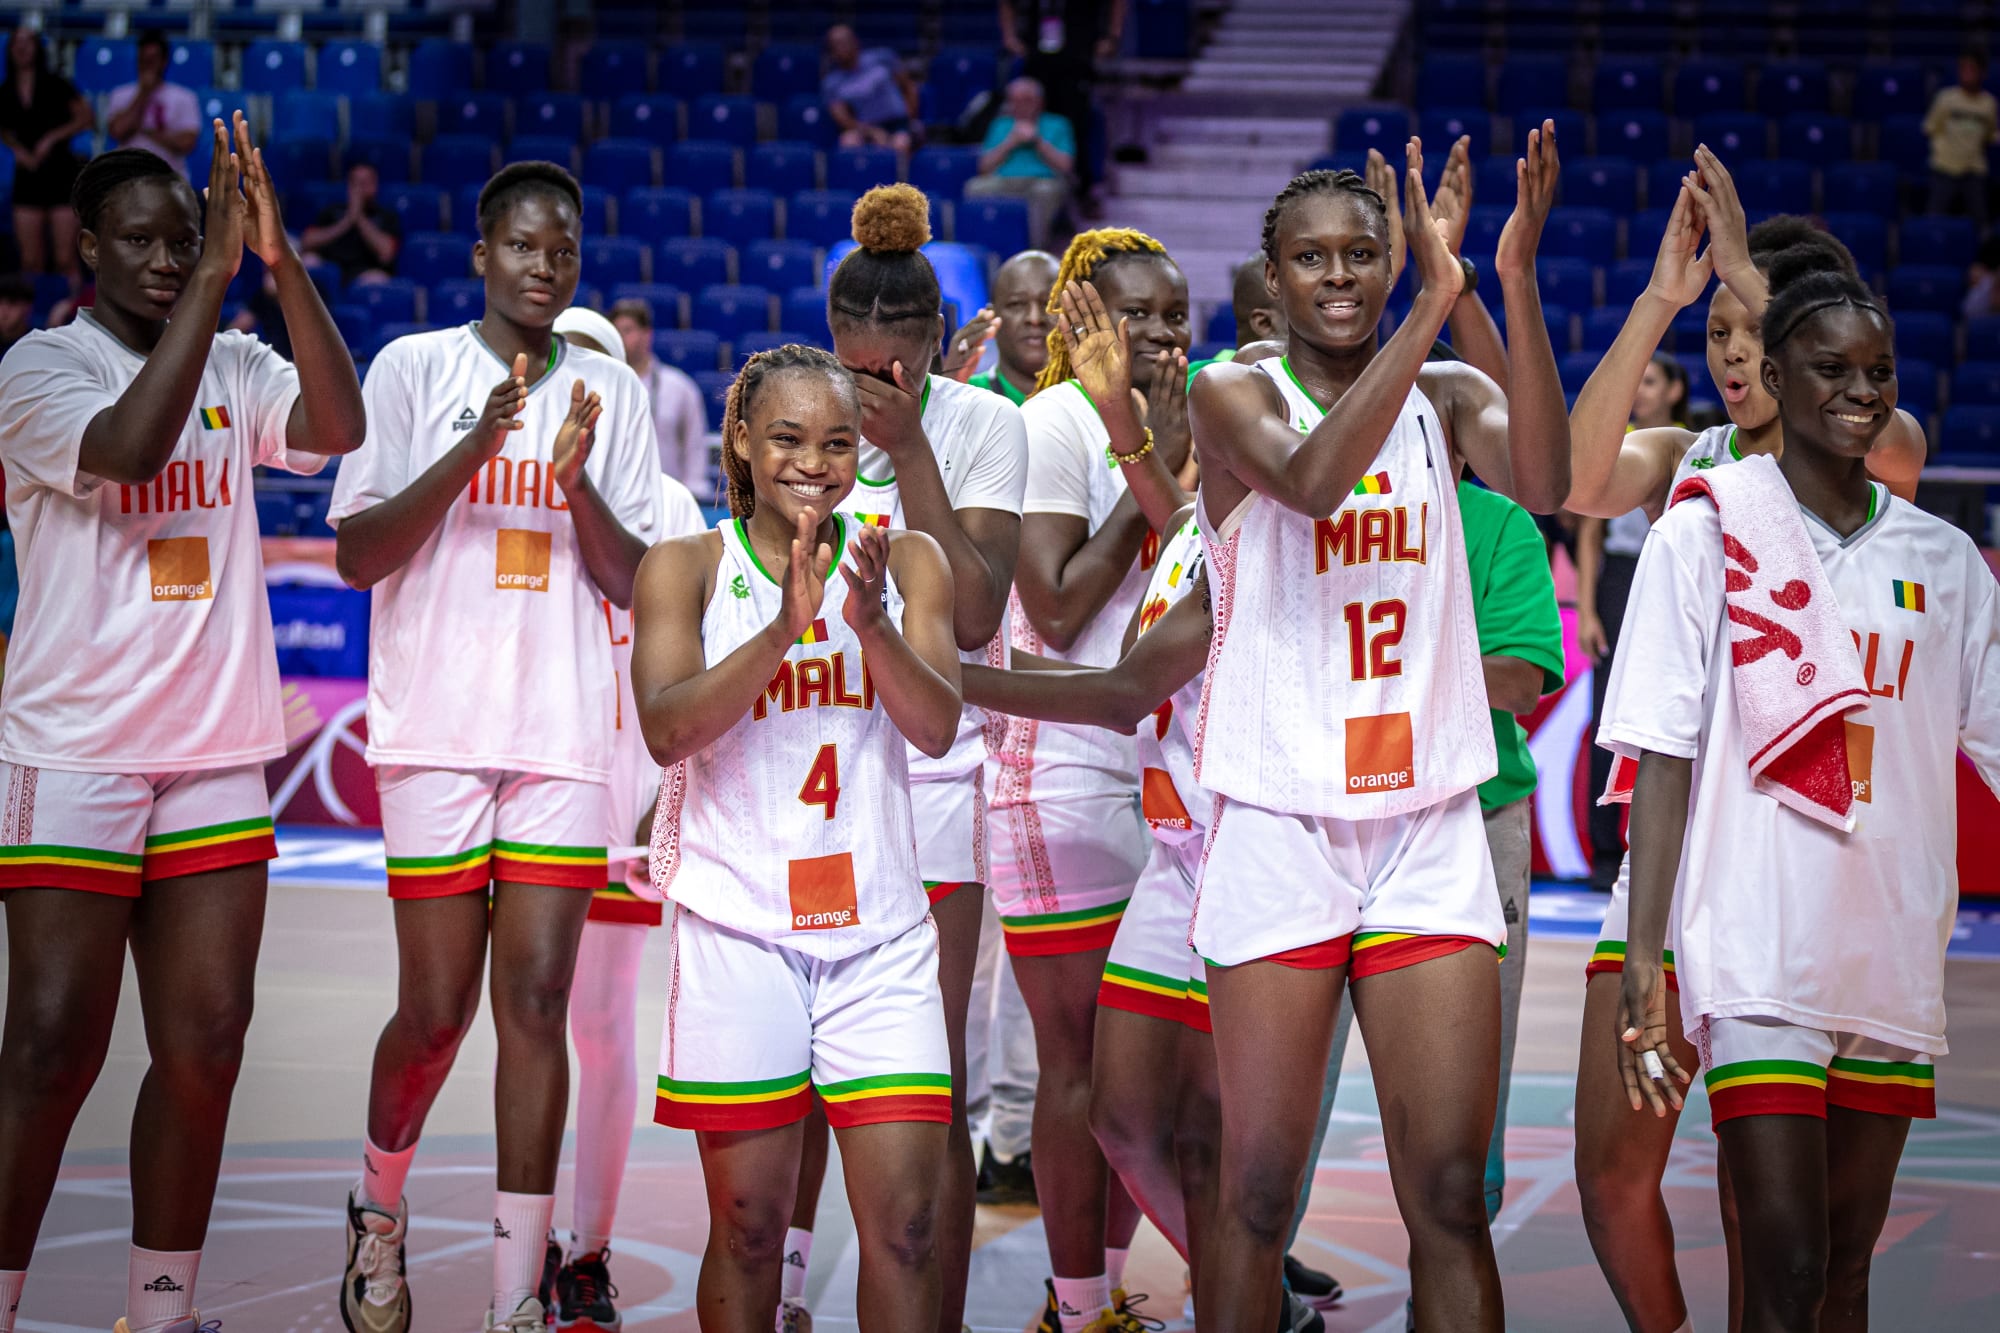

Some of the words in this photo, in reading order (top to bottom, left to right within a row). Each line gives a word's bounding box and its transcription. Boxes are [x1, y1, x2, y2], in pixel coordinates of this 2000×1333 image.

[453, 421, 477, 431] PEA
[1344, 599, 1407, 681] 12
[799, 743, 841, 821] 4
[144, 1283, 184, 1291] PEAK
